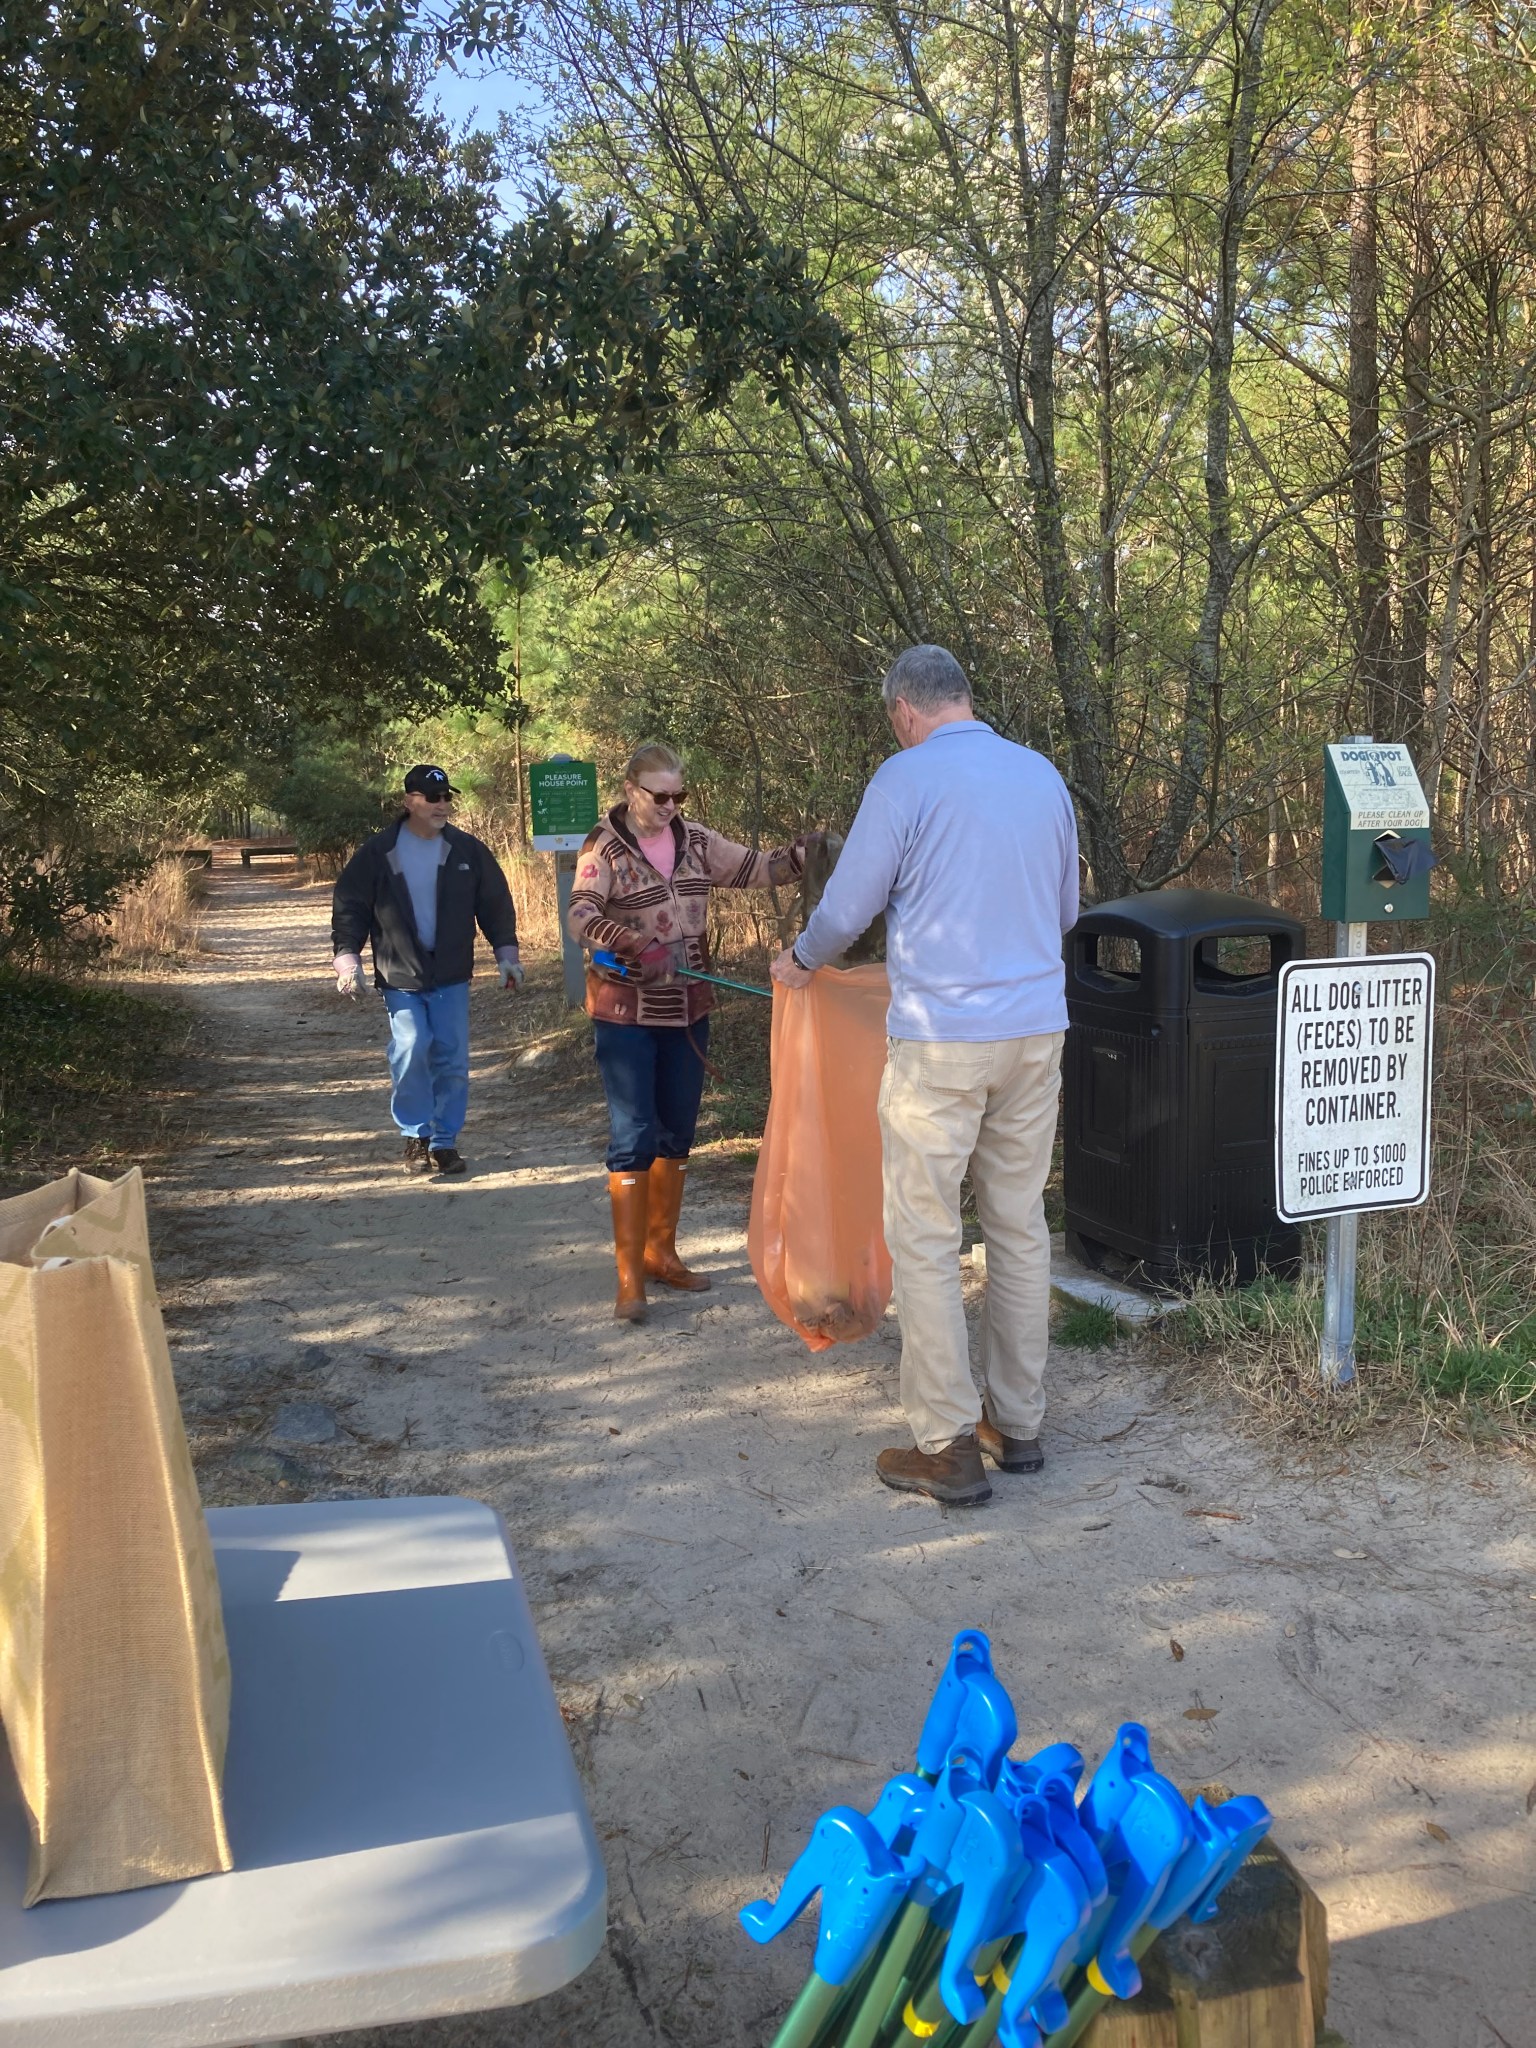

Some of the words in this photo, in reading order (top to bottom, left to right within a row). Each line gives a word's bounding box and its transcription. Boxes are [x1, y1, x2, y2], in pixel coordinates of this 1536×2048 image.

[1358, 811, 1385, 819] PLEASE
[1388, 810, 1411, 818] CLEAN
[1414, 810, 1424, 818] UP
[1358, 819, 1380, 828] AFTER
[1383, 819, 1403, 827] YOUR
[1291, 984, 1322, 1013] ALL
[1328, 980, 1361, 1011] DOG
[1367, 977, 1423, 1009] LITTER
[1297, 1018, 1362, 1054] (FECES)
[1369, 1016, 1389, 1046] TO
[1395, 1015, 1415, 1044] BE
[1301, 1055, 1381, 1089] REMOVED
[1387, 1053, 1408, 1082] BY
[1305, 1091, 1401, 1126] CONTAINER.
[1298, 1150, 1330, 1173] FINES
[1334, 1148, 1350, 1168] UP
[1354, 1146, 1369, 1167] TO
[1373, 1142, 1406, 1165] $1000
[1300, 1172, 1339, 1197] POLICE
[1343, 1166, 1404, 1192] ENFORCED
